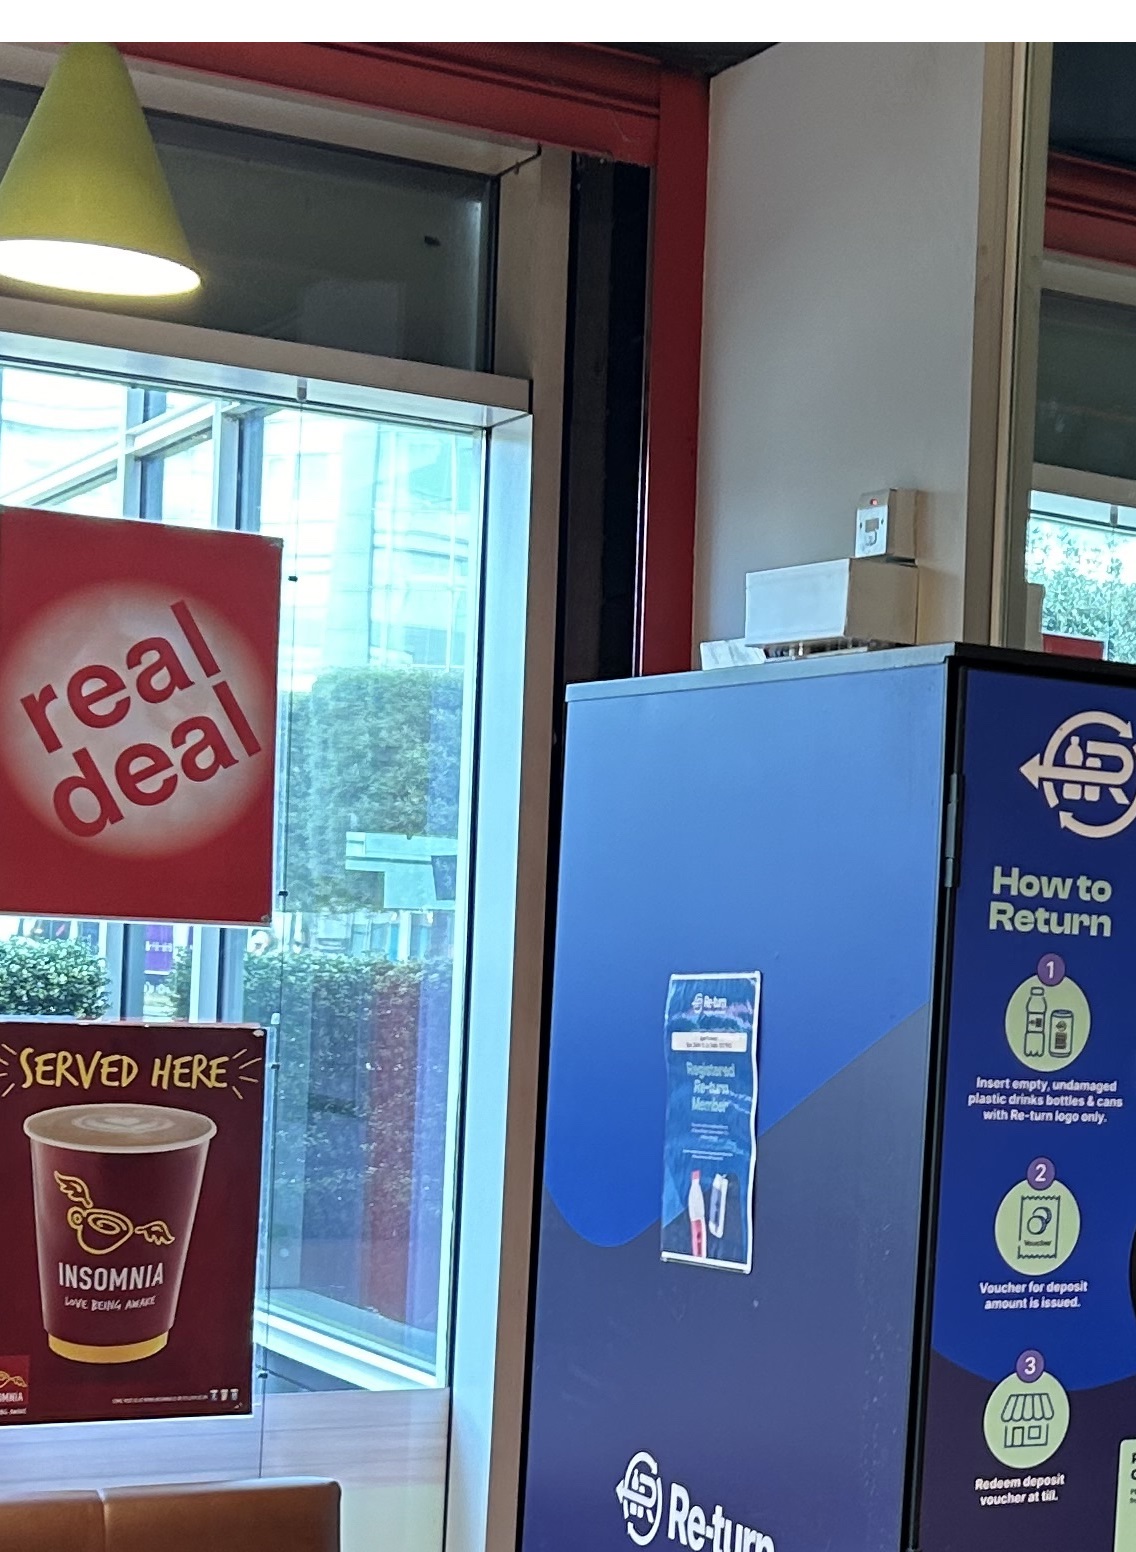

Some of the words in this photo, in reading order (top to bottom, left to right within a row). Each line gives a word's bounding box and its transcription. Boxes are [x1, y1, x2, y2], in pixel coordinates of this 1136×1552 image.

[20, 600, 221, 754] real
[52, 680, 261, 837] deal
[992, 866, 1071, 899] How
[1077, 874, 1112, 903] to
[989, 901, 1112, 937] Return
[1046, 962, 1055, 978] 1
[19, 1047, 138, 1089] SERVED
[152, 1053, 230, 1089] HERE
[976, 1077, 1010, 1089] Insert
[1012, 1078, 1050, 1092] empty,
[1052, 1080, 1117, 1094] undamaged
[968, 1093, 1007, 1106] plastic
[1009, 1093, 1044, 1106] drinks
[1046, 1095, 1085, 1107] bottles
[1087, 1096, 1095, 1107] &
[1096, 1098, 1123, 1107] cans
[983, 1109, 1008, 1121] with
[1010, 1109, 1053, 1121] Re-turn
[1055, 1110, 1079, 1124] logo
[1081, 1111, 1108, 1125] only.
[1035, 1164, 1046, 1181] 2
[58, 1262, 165, 1291] INSOMNIA
[979, 1282, 1027, 1294] Voucher
[1028, 1281, 1045, 1293] for
[1046, 1280, 1088, 1294] deposit
[64, 1296, 88, 1310] LOVE
[91, 1298, 121, 1312] BEING
[125, 1295, 155, 1310] AWAKE
[984, 1298, 1028, 1310] amount
[1029, 1296, 1040, 1308] is
[1041, 1296, 1081, 1309] issued.
[1024, 1357, 1036, 1375] 3
[975, 1478, 1021, 1491] Redeem
[1023, 1473, 1065, 1489] deposit
[980, 1492, 1026, 1506] voucher
[1028, 1492, 1040, 1503] at
[1041, 1490, 1059, 1501] till.
